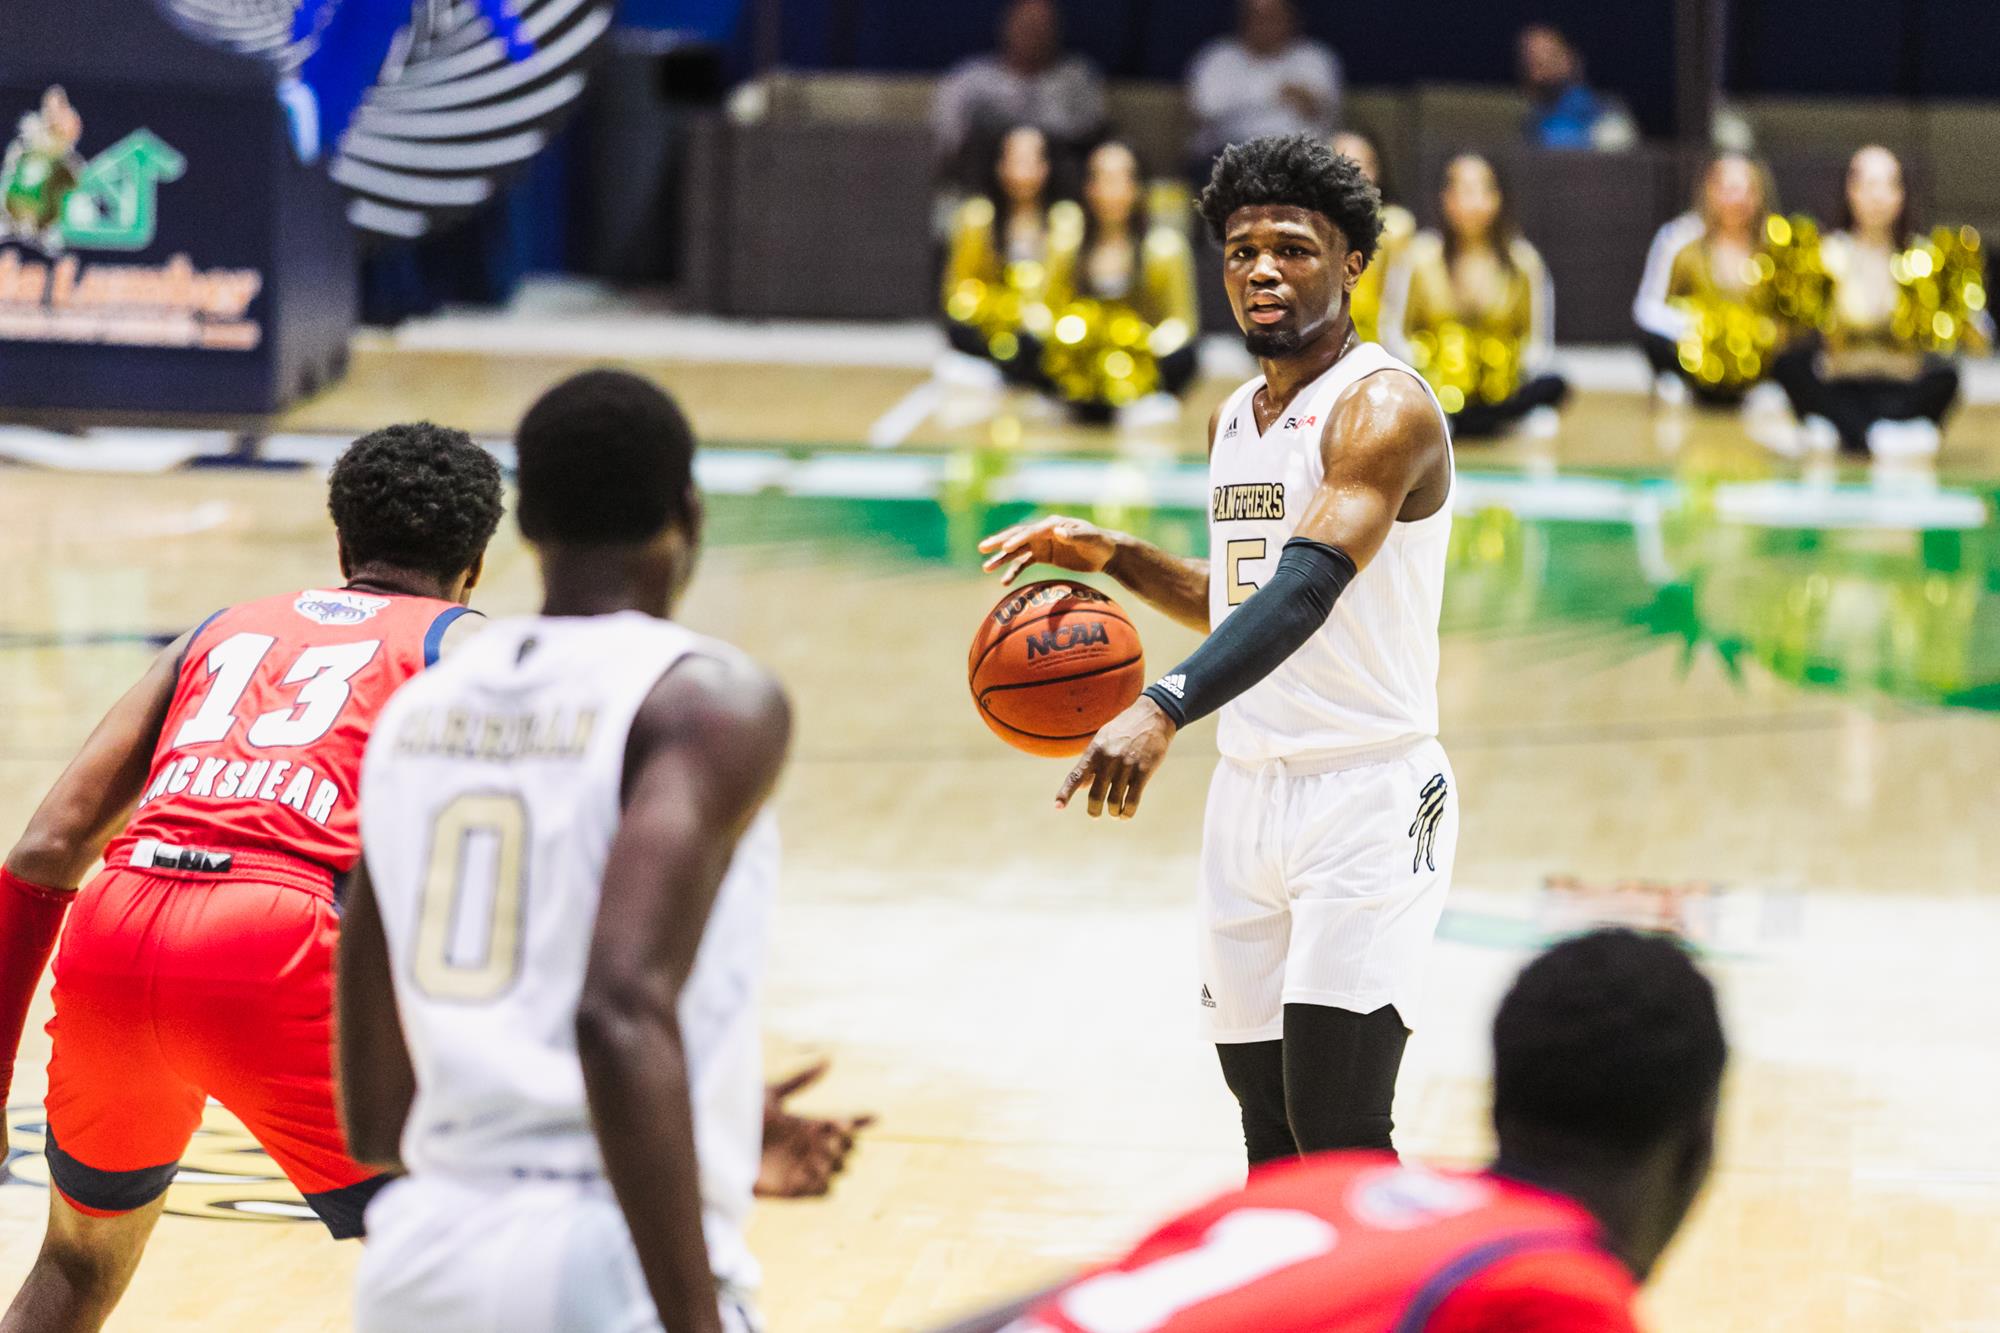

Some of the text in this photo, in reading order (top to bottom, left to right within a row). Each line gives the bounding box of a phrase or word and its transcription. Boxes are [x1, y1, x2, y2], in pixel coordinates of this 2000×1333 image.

[1213, 483, 1285, 522] PANTHERS
[1027, 622, 1110, 662] NCAA
[171, 632, 384, 749] 13
[139, 755, 340, 826] ACKSHEAR
[411, 788, 532, 1002] 0
